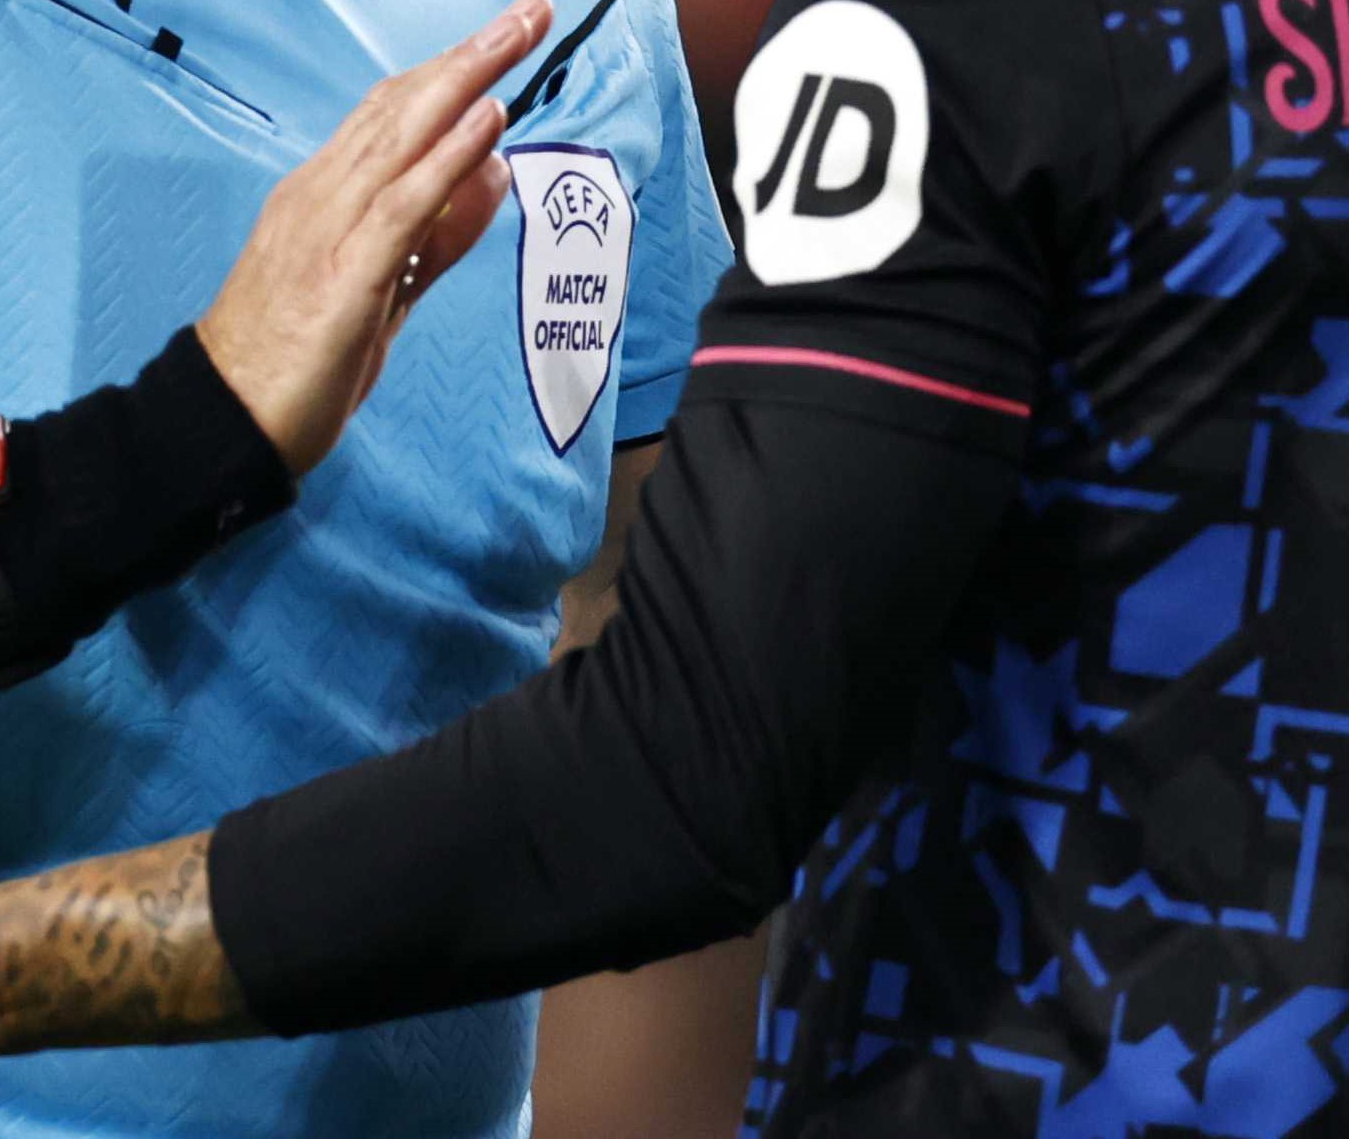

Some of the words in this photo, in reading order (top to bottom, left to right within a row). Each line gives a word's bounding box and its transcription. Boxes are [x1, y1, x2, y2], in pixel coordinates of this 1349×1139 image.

[755, 73, 896, 218] JD
[546, 183, 611, 236] UEFA
[545, 273, 608, 306] MATCH
[534, 320, 605, 351] OFFICIAL
